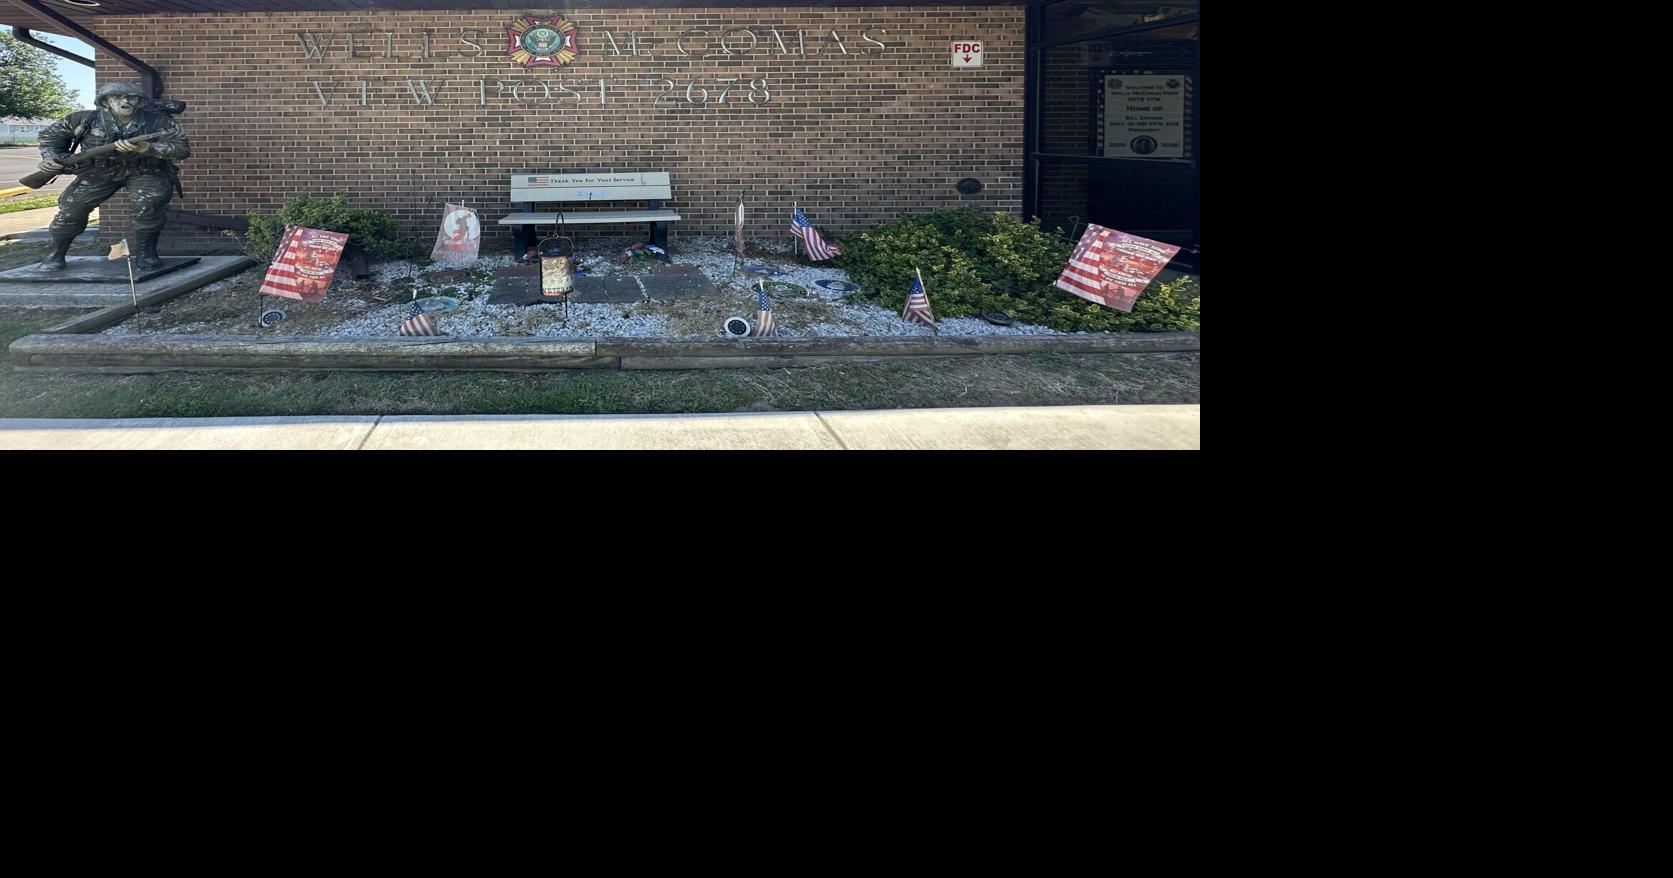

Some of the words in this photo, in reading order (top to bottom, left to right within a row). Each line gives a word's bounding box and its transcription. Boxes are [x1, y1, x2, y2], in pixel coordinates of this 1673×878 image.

[295, 30, 484, 59] WELLS
[955, 43, 980, 53] FDC
[479, 79, 616, 106] POST
[655, 78, 770, 105] 2678
